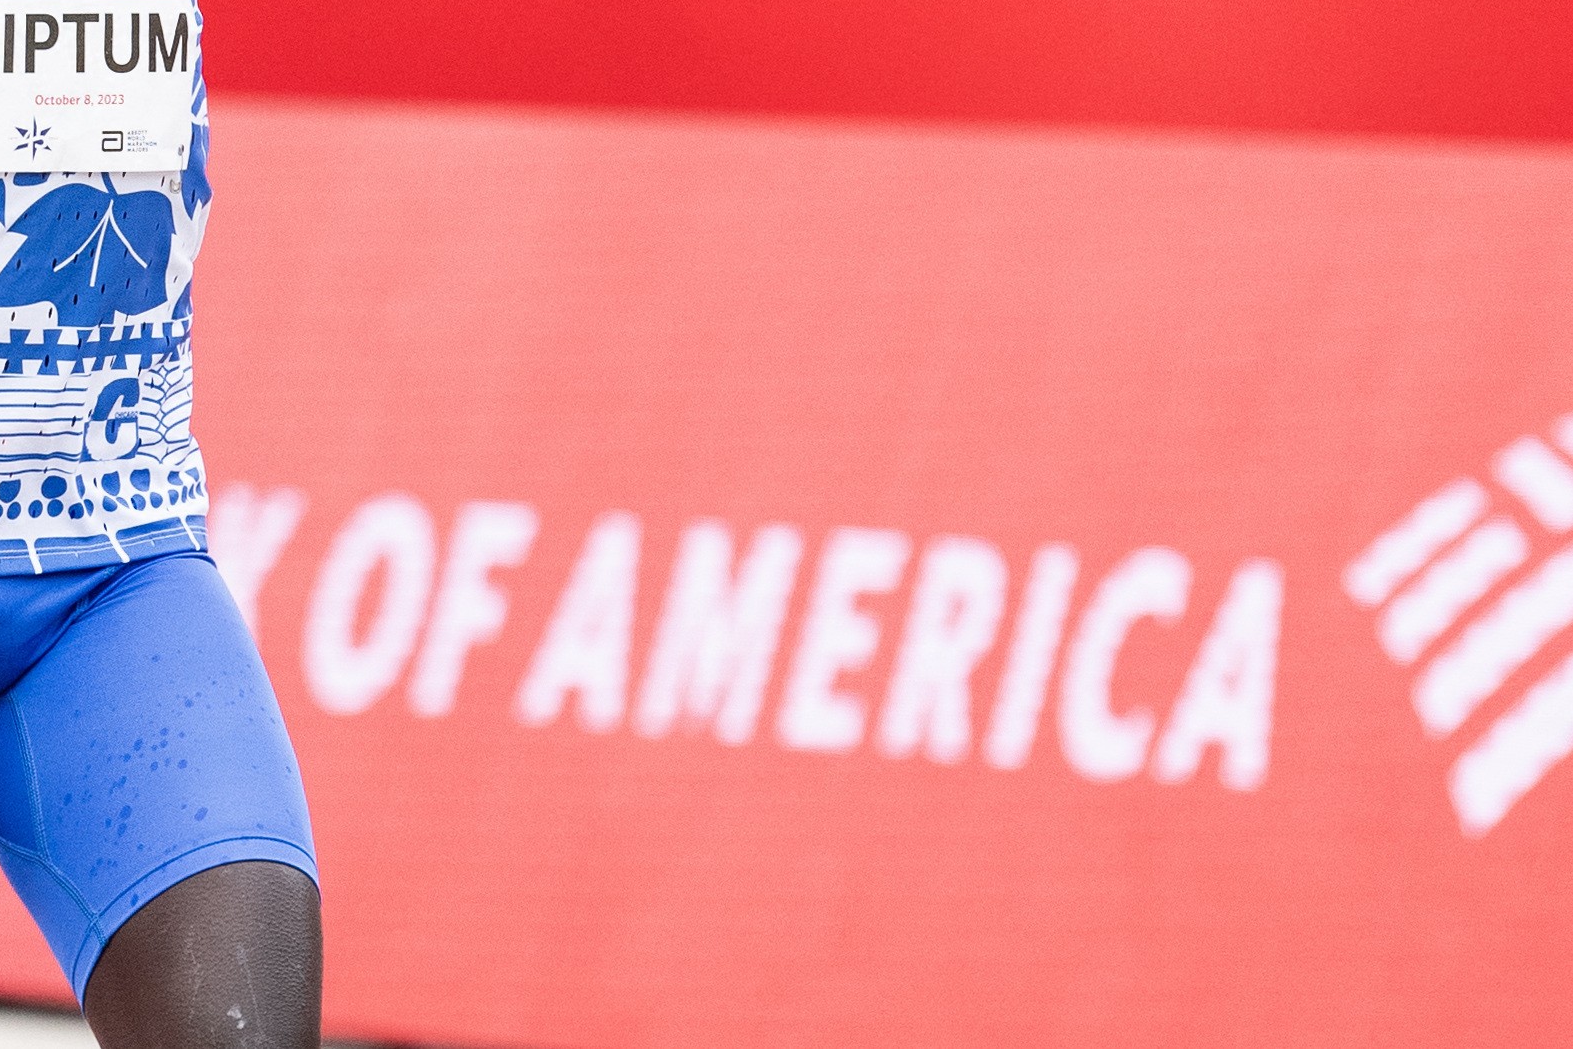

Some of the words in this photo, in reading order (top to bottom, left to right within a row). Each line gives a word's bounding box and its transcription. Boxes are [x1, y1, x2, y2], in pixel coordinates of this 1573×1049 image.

[35, 94, 81, 105] October
[83, 94, 95, 107] 8,
[97, 94, 125, 105] 2023
[303, 491, 540, 719] OF
[516, 509, 1284, 792] AMERICA
